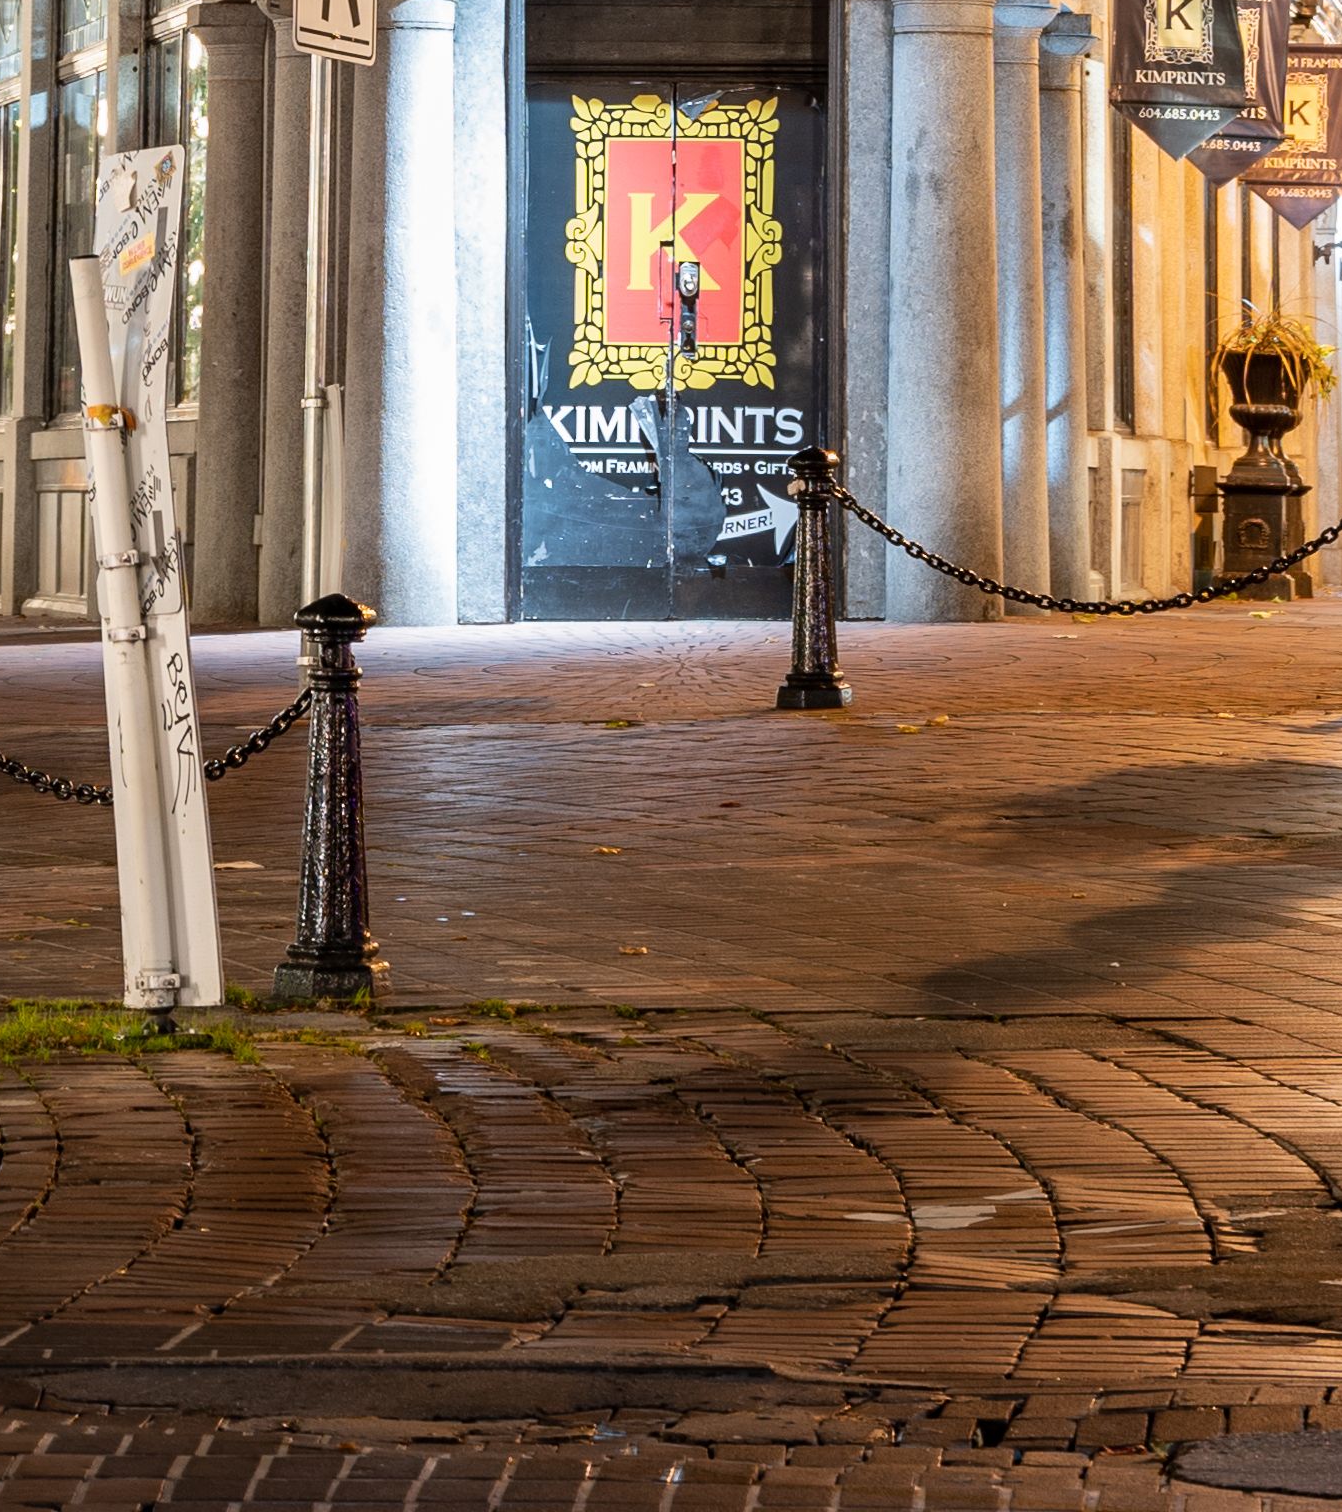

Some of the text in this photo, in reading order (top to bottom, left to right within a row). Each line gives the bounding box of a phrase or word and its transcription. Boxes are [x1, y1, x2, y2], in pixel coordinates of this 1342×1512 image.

[1135, 69, 1226, 86] KIMPRINTS
[1138, 107, 1221, 121] 604.685.0443
[1288, 100, 1311, 126] K
[1263, 157, 1338, 170] KIMPRINTS
[625, 192, 721, 292] K
[542, 405, 805, 445] KIMINTS
[605, 459, 660, 474] FRAMIN
